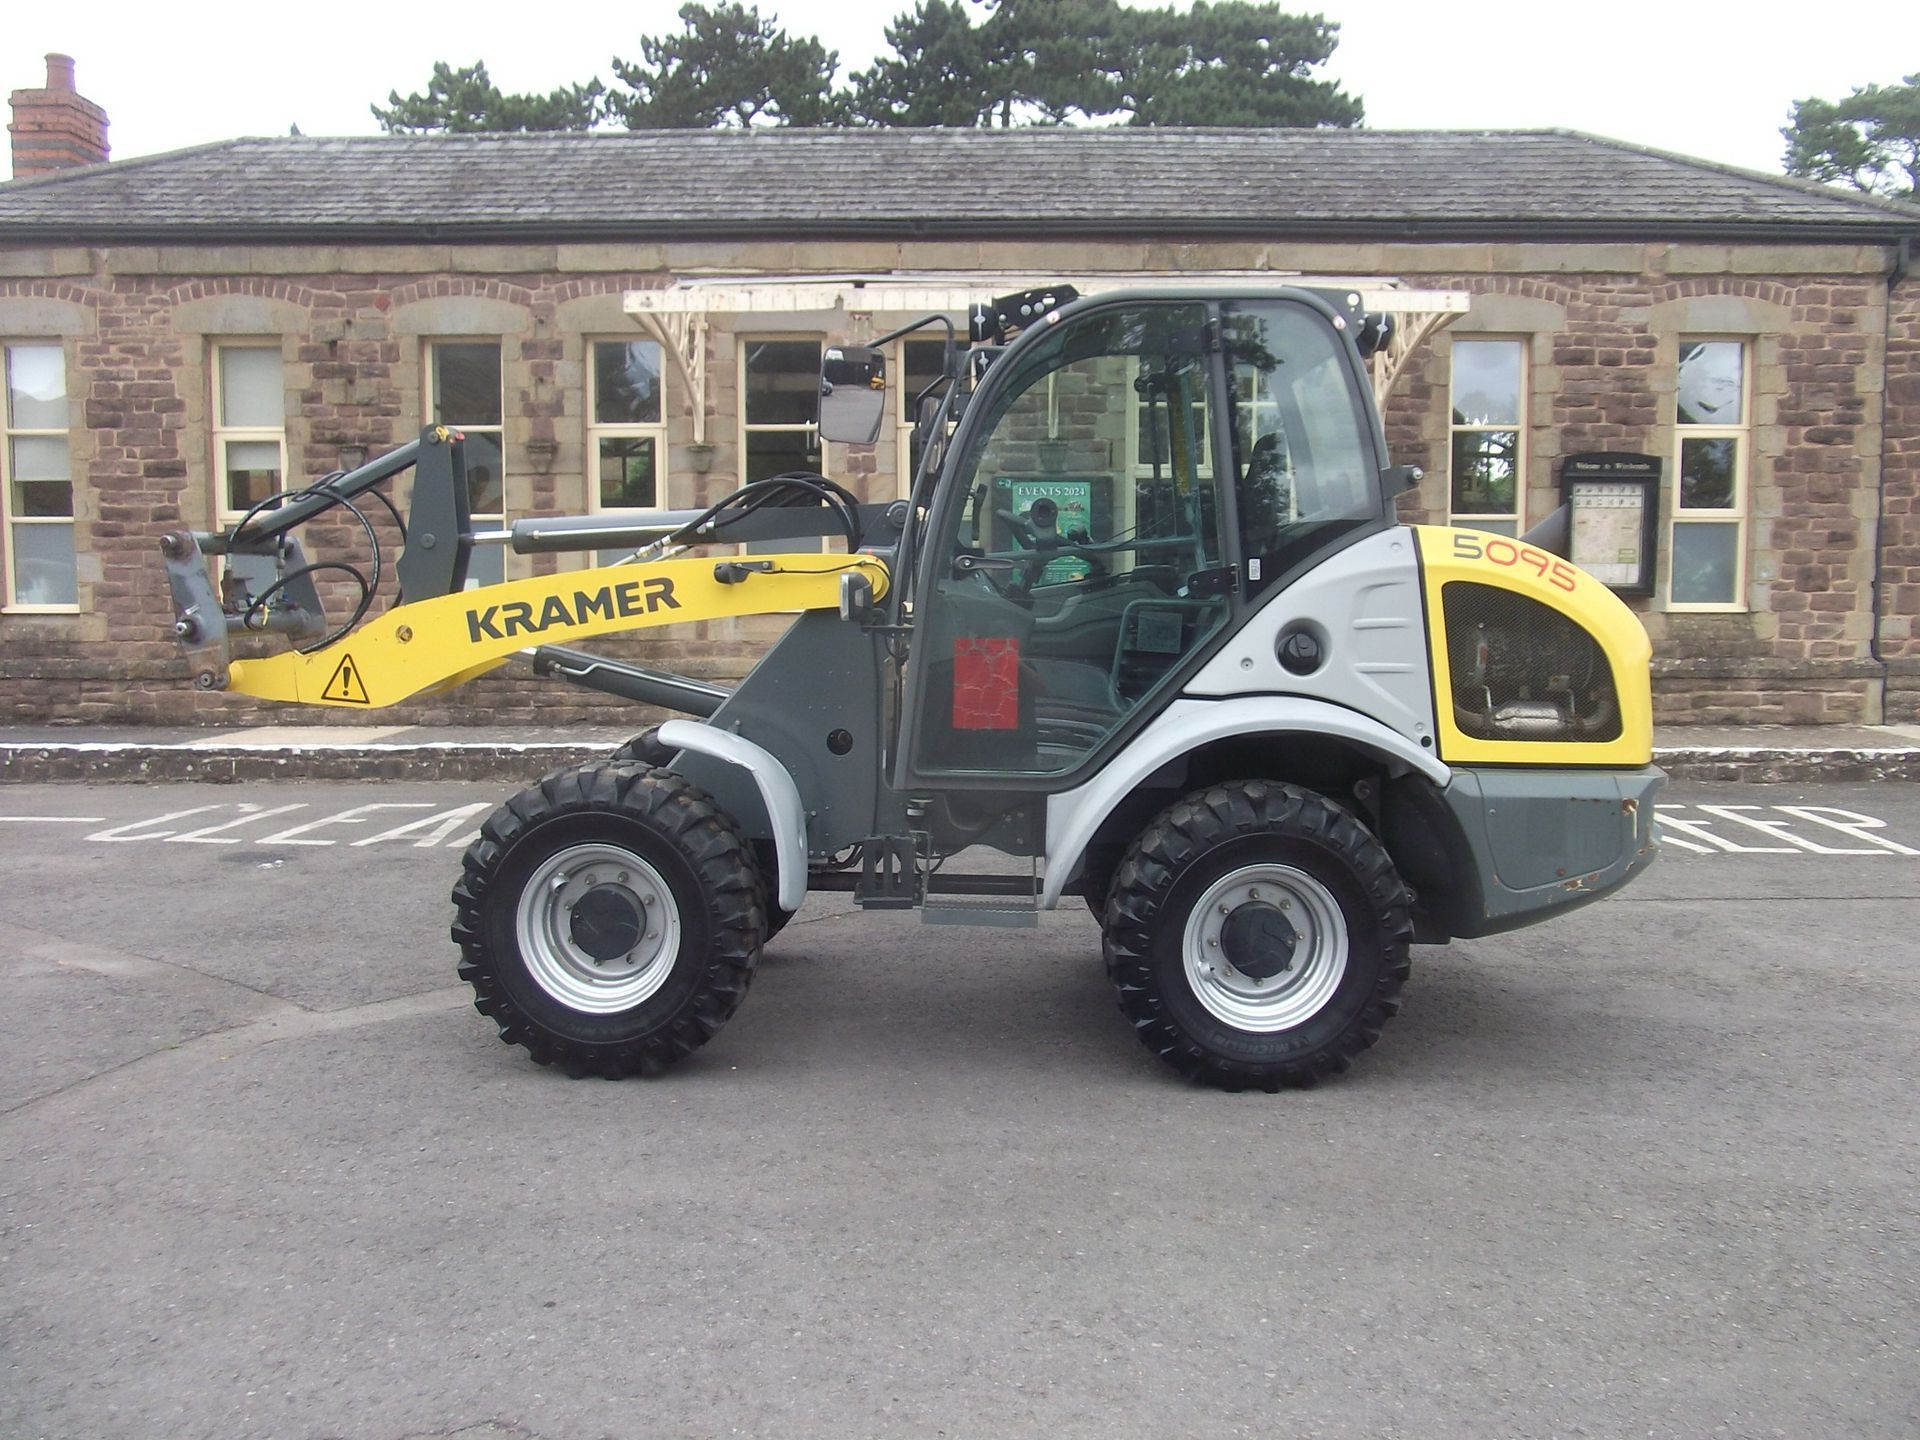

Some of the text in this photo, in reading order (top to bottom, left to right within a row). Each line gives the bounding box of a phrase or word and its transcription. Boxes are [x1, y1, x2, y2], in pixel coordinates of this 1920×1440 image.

[1018, 486, 1086, 496] EVENTS 2024
[1453, 533, 1577, 592] 5095
[465, 577, 682, 643] KRAMER
[83, 802, 493, 847] CLEA
[1654, 803, 1920, 855] EEP
